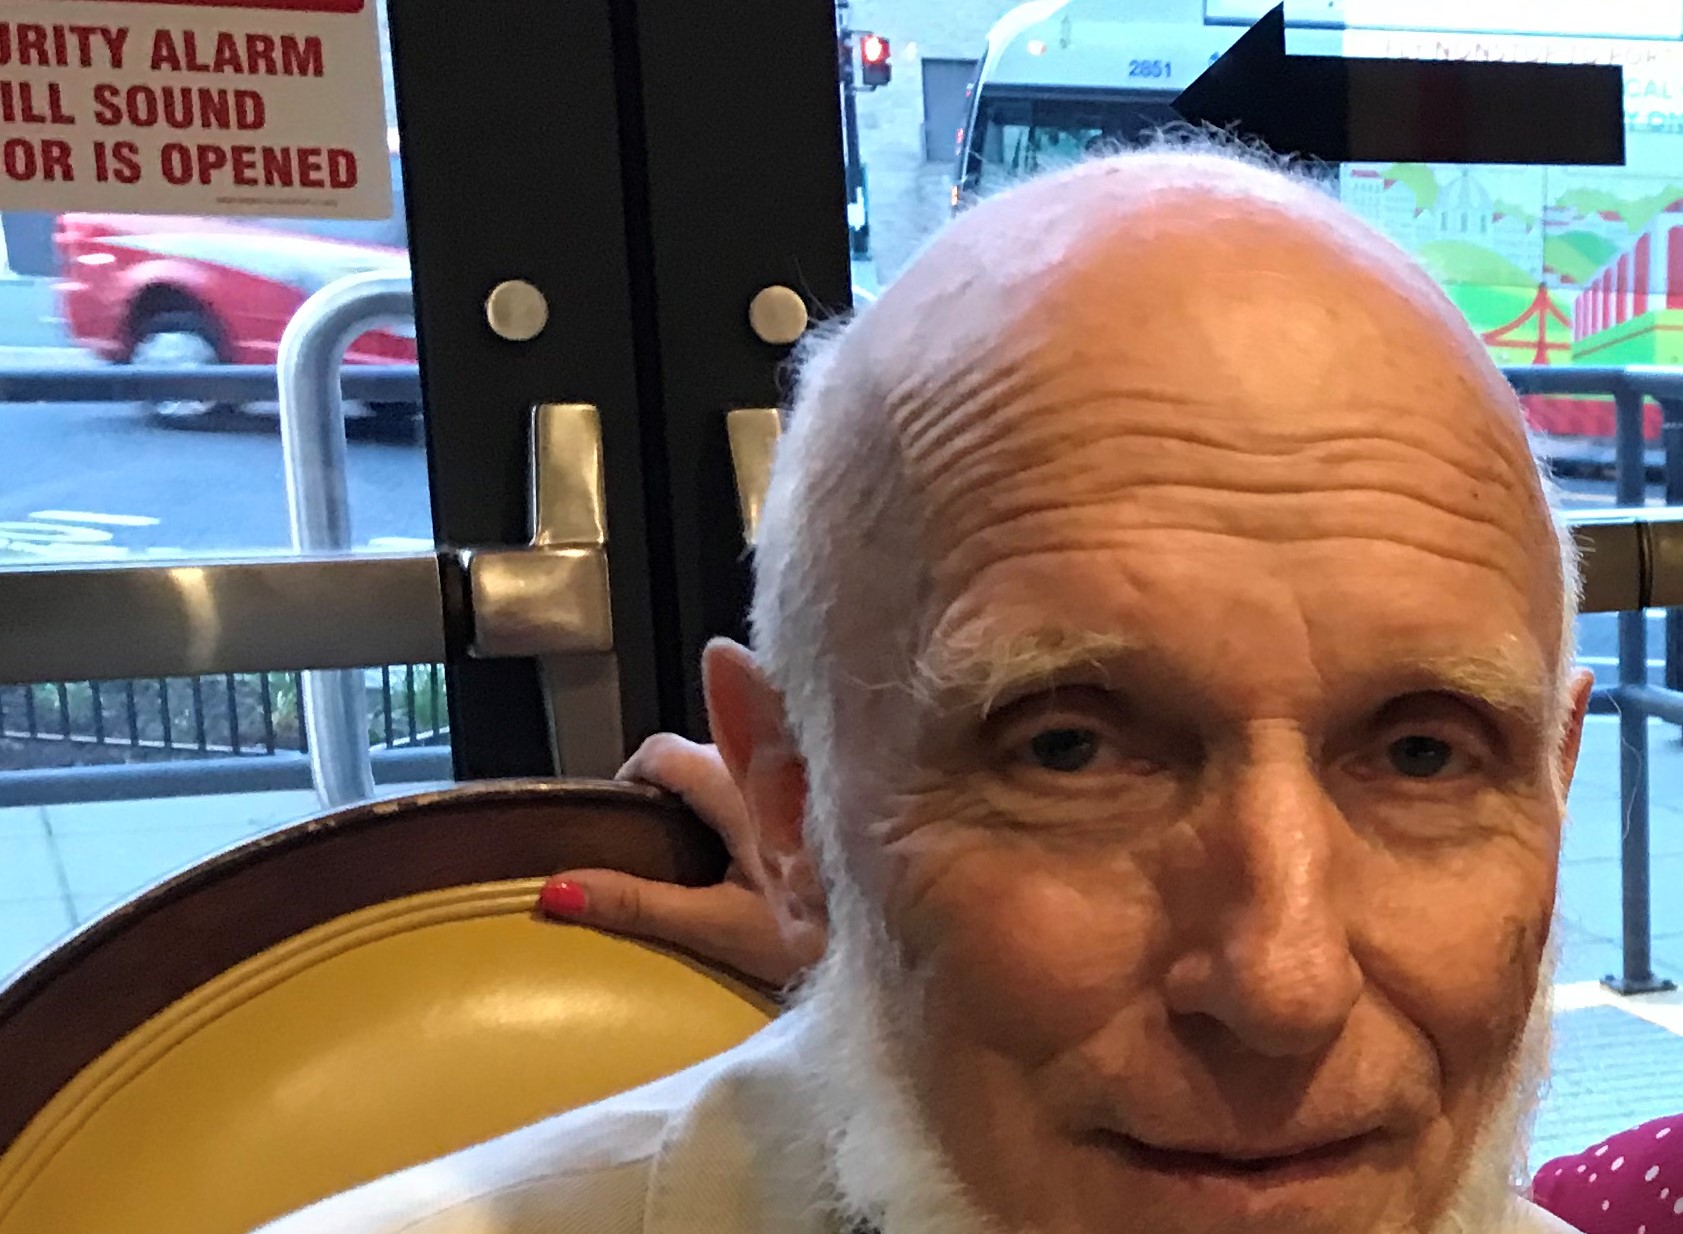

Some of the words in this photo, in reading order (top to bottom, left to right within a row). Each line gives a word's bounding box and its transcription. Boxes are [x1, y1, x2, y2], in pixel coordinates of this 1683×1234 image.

[151, 29, 324, 77] ALARM
[1129, 60, 1171, 78] 2851
[94, 84, 265, 130] SOUND
[4, 138, 74, 182] OR
[93, 140, 142, 184] IS
[161, 143, 358, 189] OPENED
